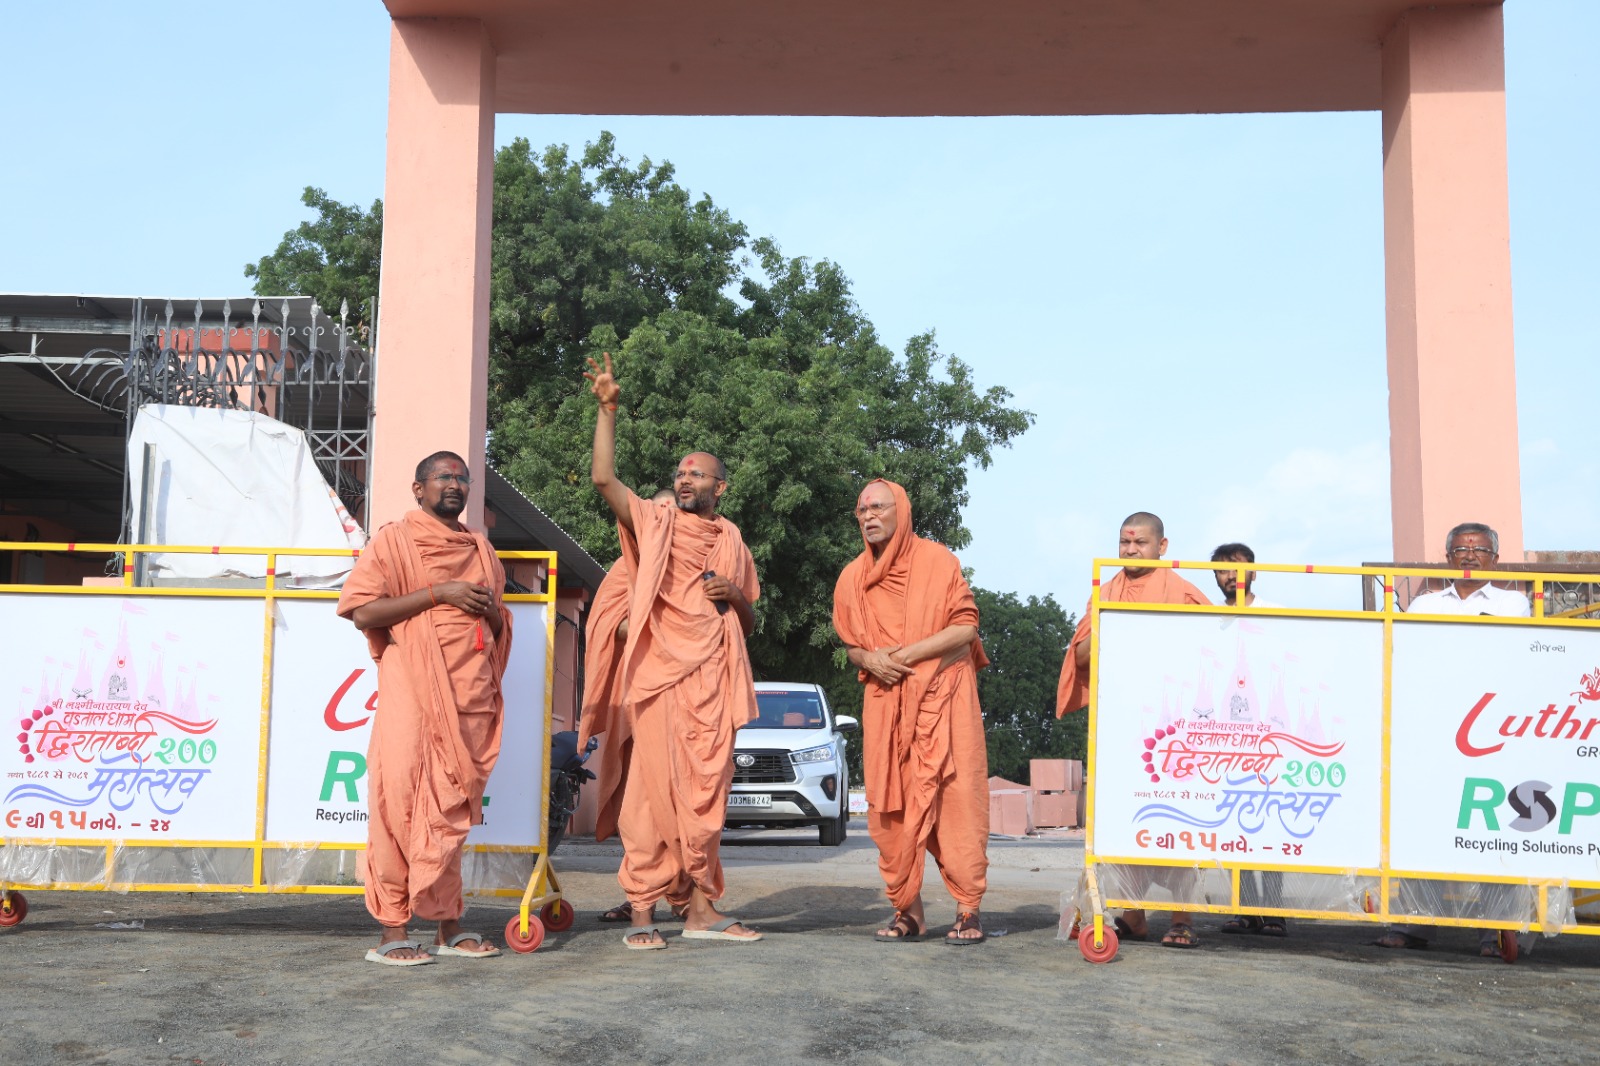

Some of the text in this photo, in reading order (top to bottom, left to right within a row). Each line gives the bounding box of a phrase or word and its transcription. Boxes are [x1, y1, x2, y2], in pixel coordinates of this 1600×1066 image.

[1530, 640, 1566, 653] સૌજન્ય
[52, 698, 63, 709] श्री
[133, 700, 148, 711] देव
[1174, 718, 1185, 729] श्री
[1256, 721, 1271, 732] देव
[25, 813, 45, 829] થી
[1155, 833, 1175, 850] થી
[1455, 836, 1518, 854] Recycling
[1522, 840, 1583, 855] Solutions
